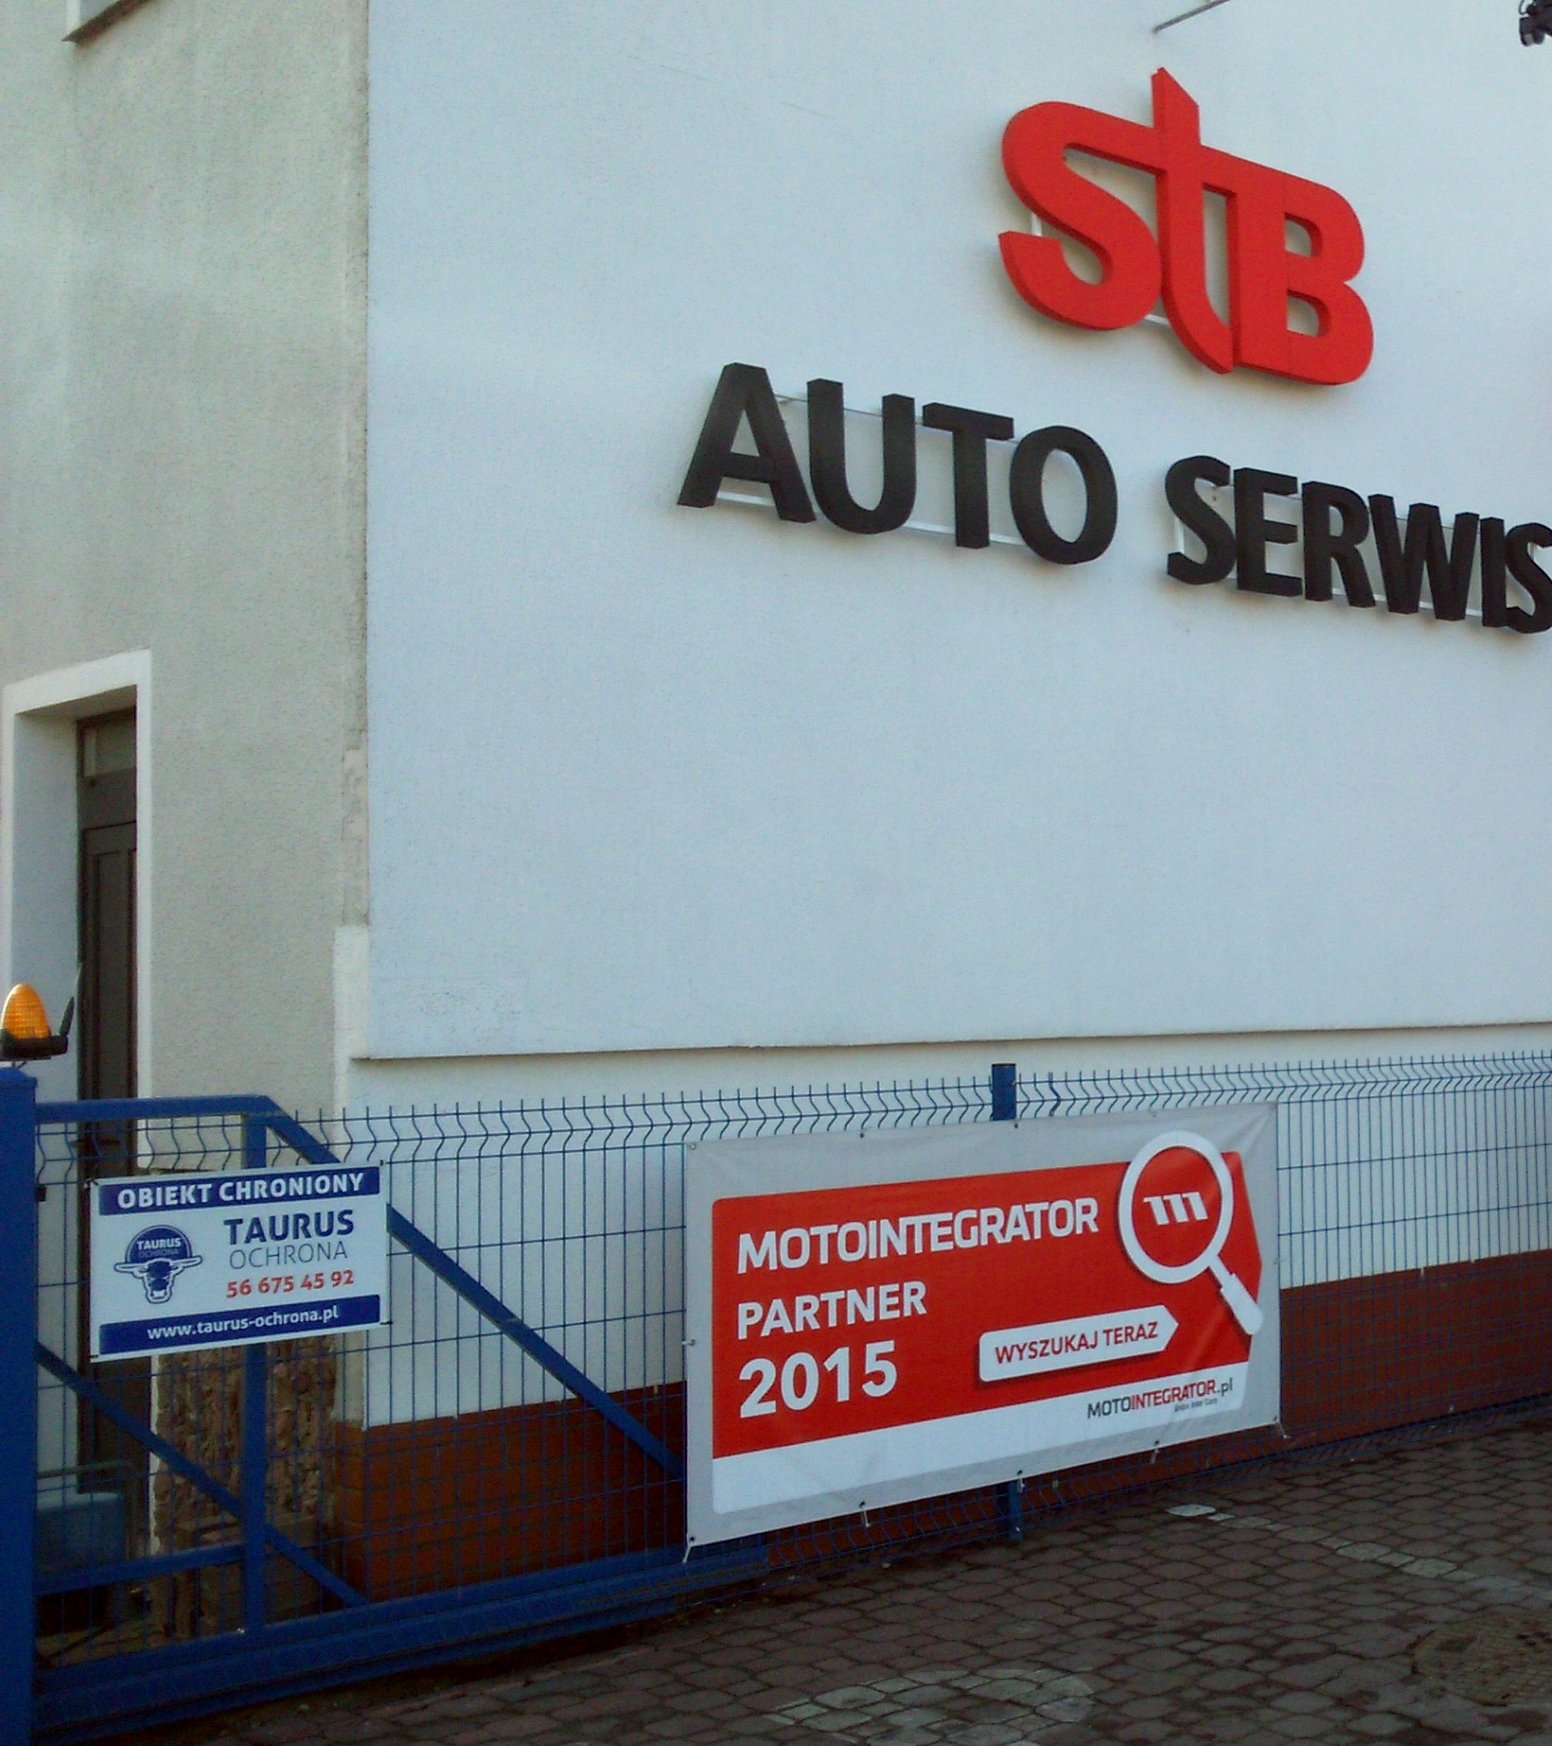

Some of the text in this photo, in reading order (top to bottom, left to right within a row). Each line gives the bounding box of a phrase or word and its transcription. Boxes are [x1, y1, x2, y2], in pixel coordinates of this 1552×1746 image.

[677, 361, 1118, 565] AUTO
[117, 1172, 365, 1209] OBIEKT CHRONIONY
[137, 1238, 181, 1250] TAURUS
[223, 1209, 354, 1245] TAURUS
[737, 1196, 1099, 1275] MOTOINTEGRATOR
[229, 1240, 348, 1270] OCHRONA
[226, 1269, 354, 1299] 56 675 45 92
[147, 1305, 339, 1341] www.taurus-ochrona.pl
[737, 1280, 927, 1340] PARTNER
[994, 1321, 1159, 1364] WYSZUKAJ TERAZ
[739, 1339, 898, 1419] 2015
[1087, 1377, 1233, 1419] MOTOINTEGRATOR.pl
